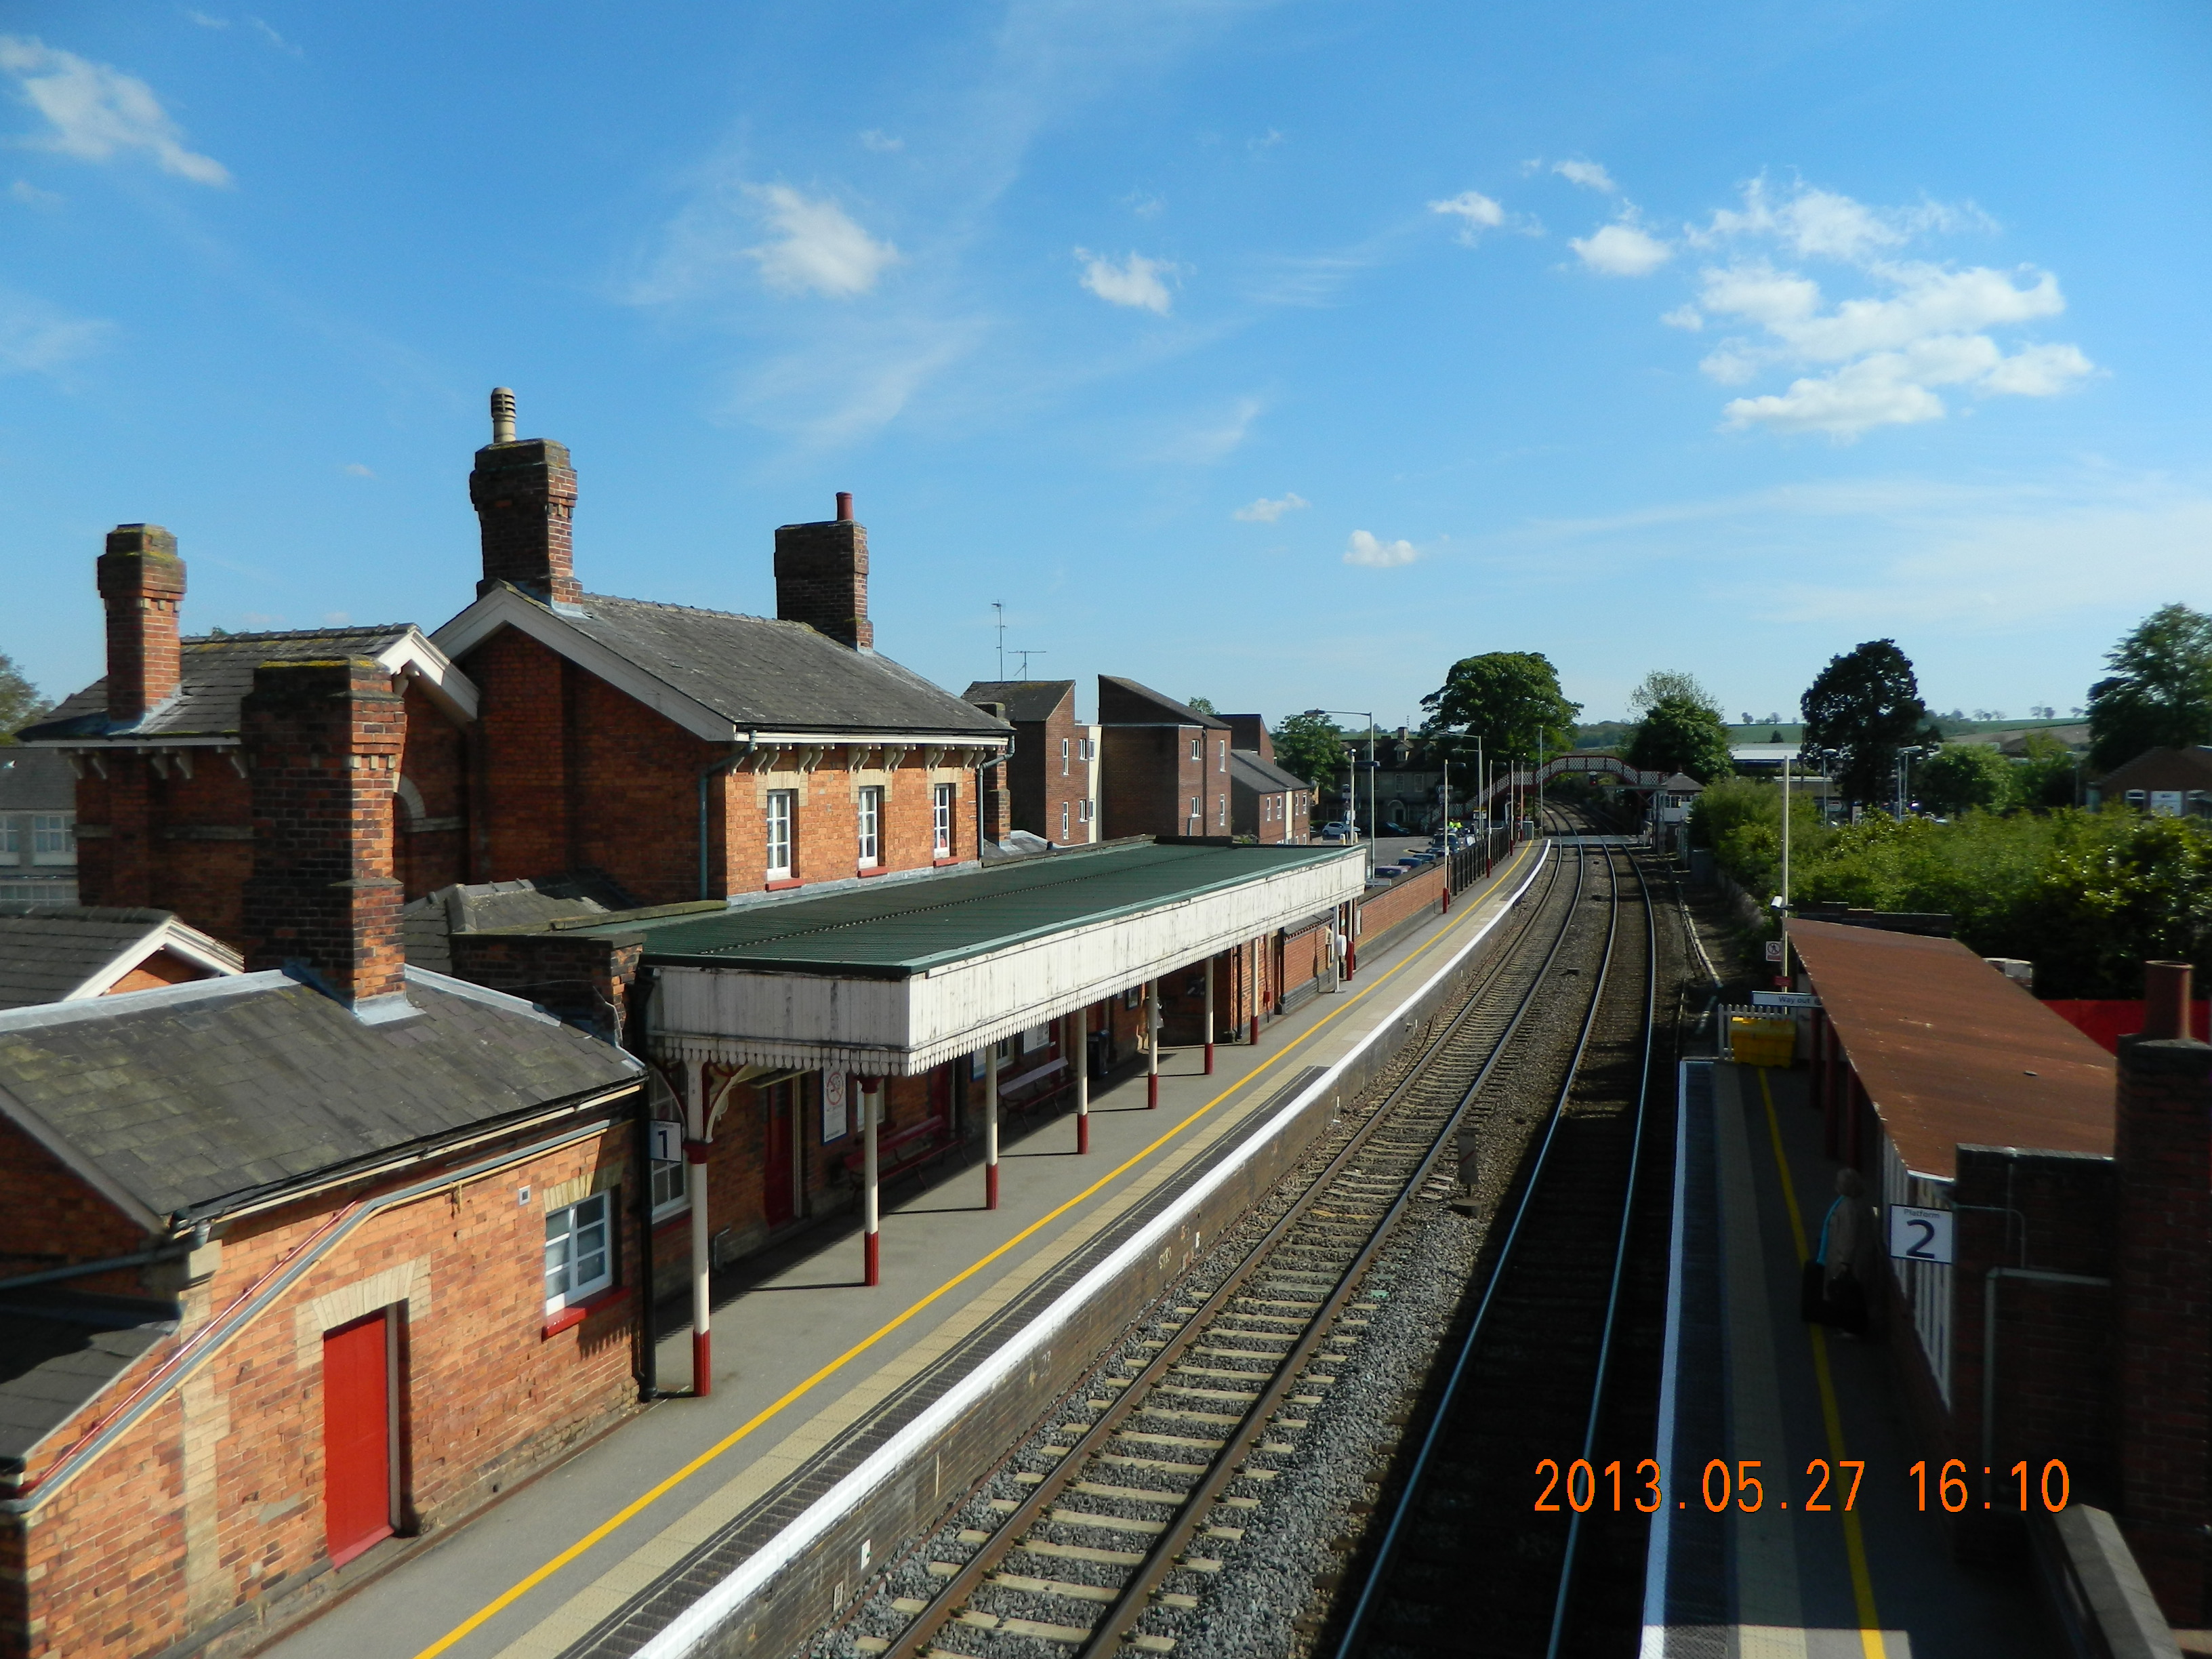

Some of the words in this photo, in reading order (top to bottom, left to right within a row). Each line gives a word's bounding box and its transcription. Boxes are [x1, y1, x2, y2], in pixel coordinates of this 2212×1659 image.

[1778, 996, 1795, 1004] Way
[657, 1130, 668, 1159] 1
[1904, 1208, 1940, 1218] Platform
[1906, 1219, 1935, 1259] 2
